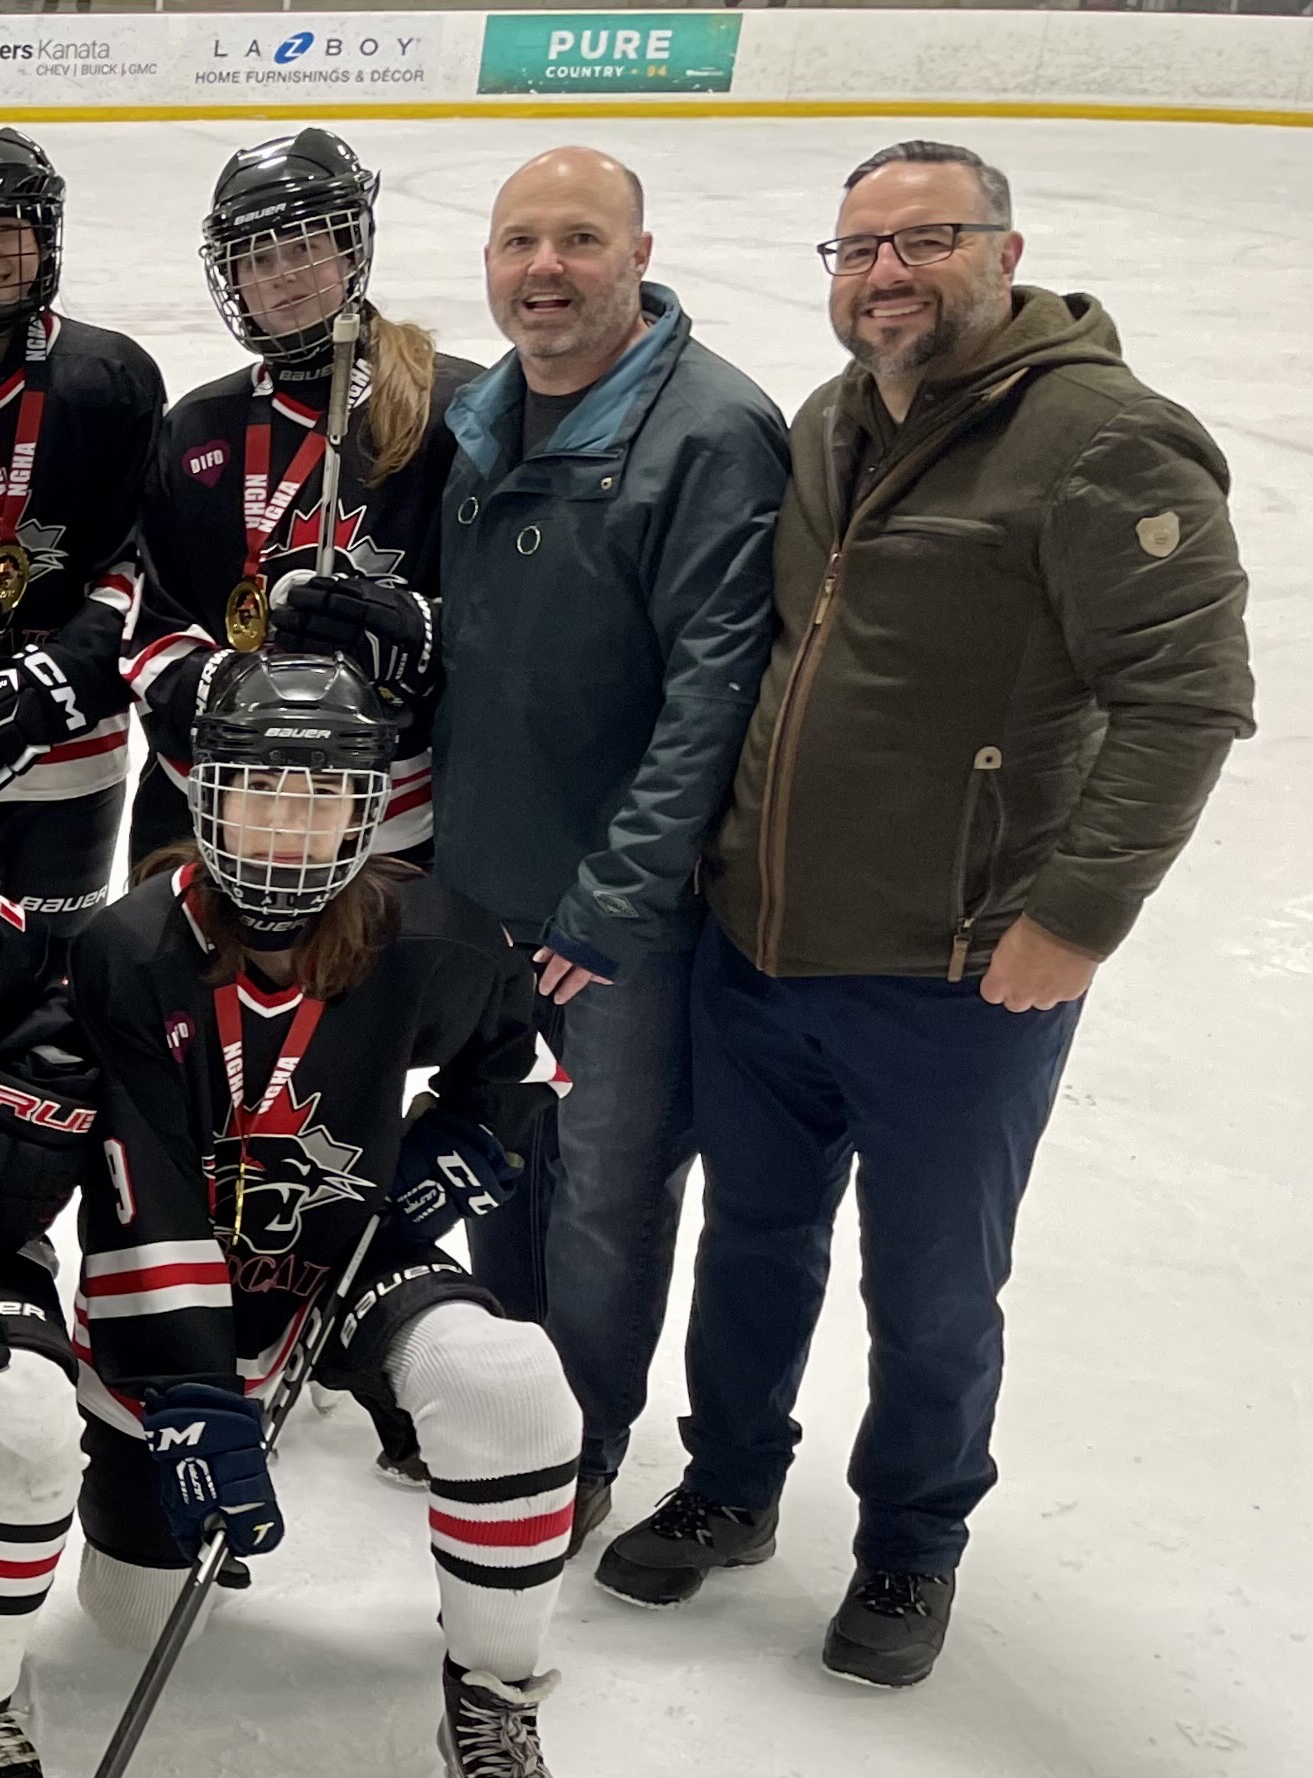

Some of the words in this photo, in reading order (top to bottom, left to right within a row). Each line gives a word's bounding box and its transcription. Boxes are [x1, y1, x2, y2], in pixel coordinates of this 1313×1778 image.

[37, 39, 111, 60] Kanata
[548, 29, 673, 61] PURE
[36, 64, 70, 76] CHEV
[81, 64, 118, 76] BUICK
[129, 63, 158, 76] GMC
[195, 71, 240, 84] HOME
[246, 69, 351, 84] FURNISHINGS
[356, 70, 365, 83] &
[545, 66, 625, 78] COUNTRY
[233, 201, 288, 226] BAUER
[278, 364, 333, 382] BAUE
[6, 441, 36, 497] NGHA
[189, 448, 225, 475] DIFD
[244, 474, 268, 529] NGHA
[257, 480, 300, 533] NGHA
[265, 726, 332, 741] BAUER
[20, 885, 108, 913] BAUER
